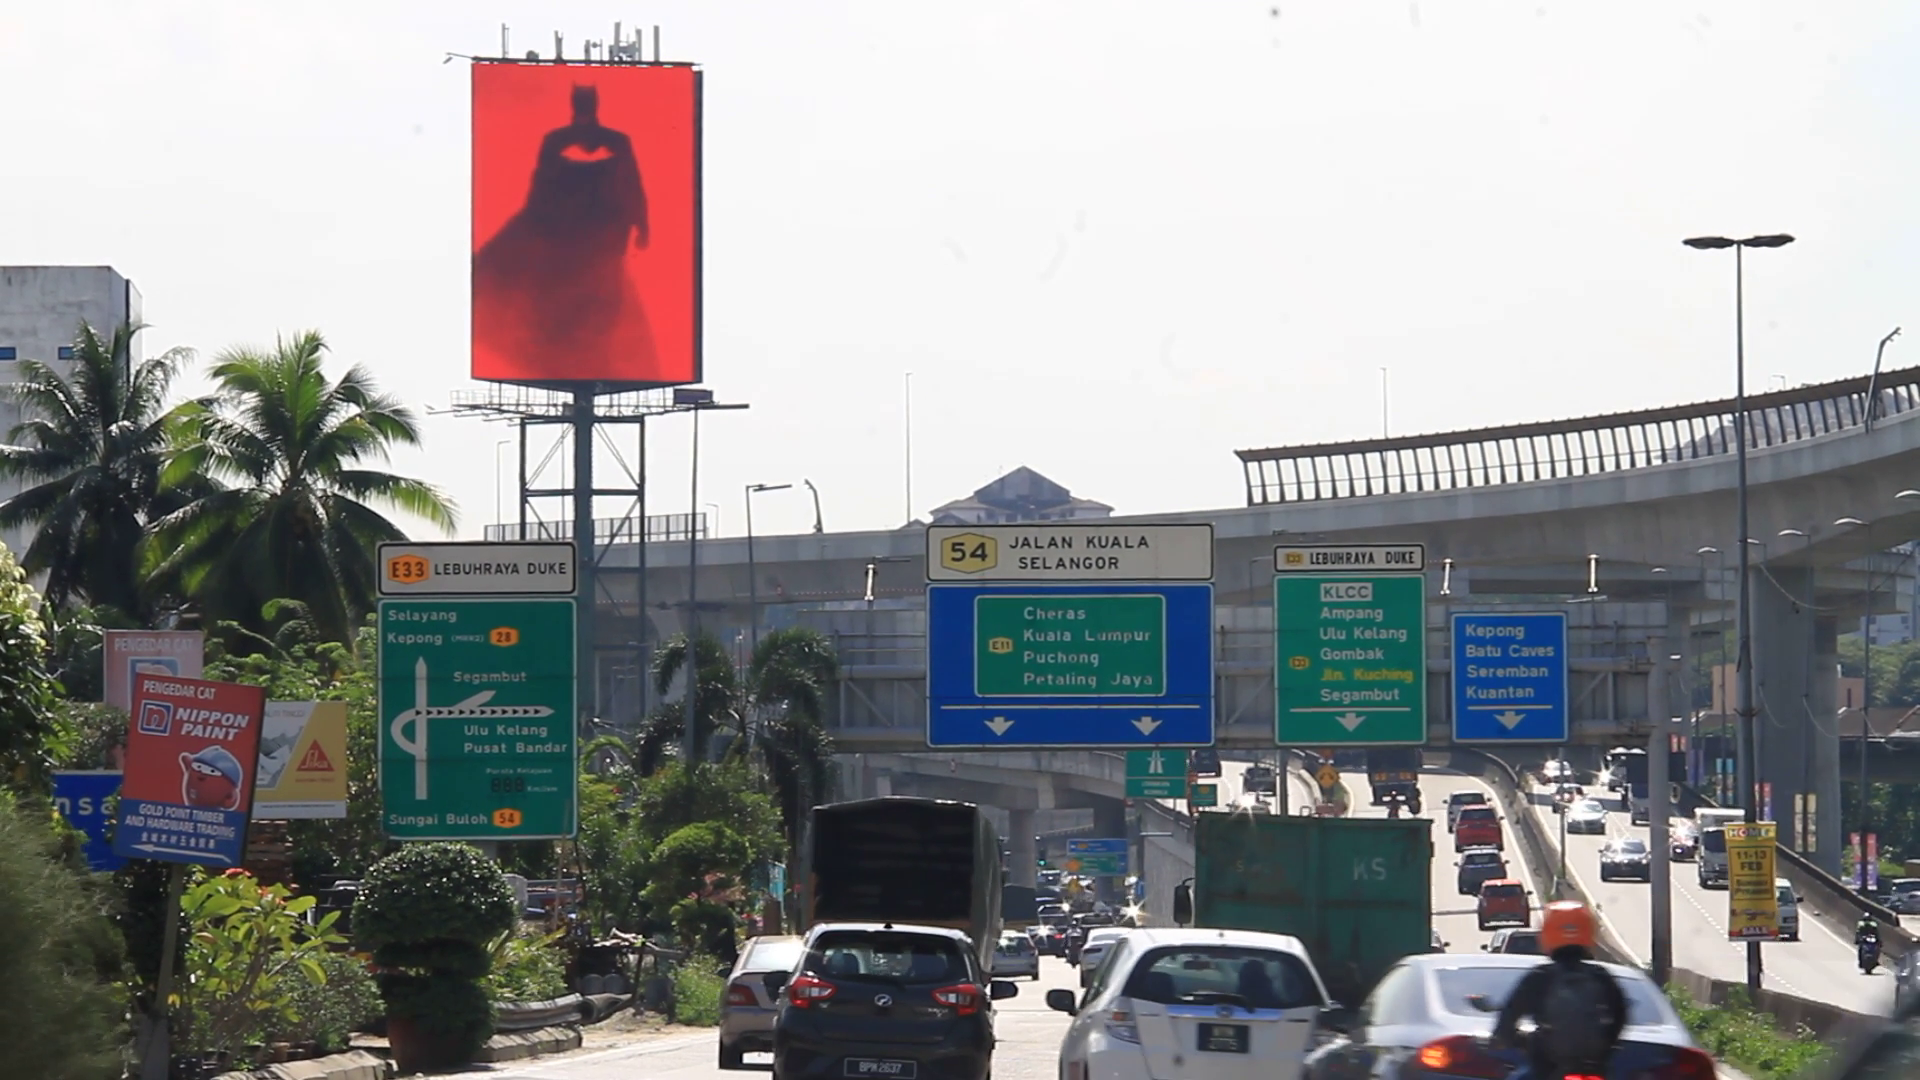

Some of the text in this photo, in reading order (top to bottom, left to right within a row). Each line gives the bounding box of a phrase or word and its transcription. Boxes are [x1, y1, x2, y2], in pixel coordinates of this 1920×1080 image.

[1009, 536, 1150, 549] JALAN KUALA
[950, 542, 988, 562] 54
[1310, 552, 1375, 565] LEBUHRAYA
[1386, 551, 1415, 564] DUKE
[391, 562, 567, 578] E33 LEBUHRAYA DUKE
[1018, 557, 1119, 570] SELANGOR
[1323, 586, 1369, 598] KLCC
[388, 609, 457, 623] Selayang
[1023, 607, 1086, 620] Cheras
[1320, 607, 1383, 622] Ampang
[387, 632, 443, 645] Kepong
[495, 632, 512, 642] 28
[1023, 629, 1151, 644] Kuala Lumpur
[1320, 628, 1407, 642] Ulu Kelang
[1466, 624, 1525, 639] Kepong
[114, 638, 193, 652] PENGEDAR CAT
[992, 640, 1010, 651] E11
[1466, 645, 1554, 657] Batu Caves
[1023, 652, 1099, 667] Puchong
[1320, 648, 1384, 660] Gombak
[453, 671, 527, 684] Segambut
[1353, 669, 1413, 683] Kuching
[1466, 665, 1550, 677] Seremban
[1023, 673, 1153, 689] Petaling Jaya
[143, 680, 216, 700] PENGEDAR CAT
[1320, 688, 1399, 703] Segambut
[1466, 686, 1534, 699] Kuantan
[175, 708, 249, 728] NIPPON
[181, 723, 239, 741] PAINT
[464, 725, 548, 738] Ulu Kelang
[464, 742, 568, 754] Pusat Bandar
[139, 804, 225, 823] GOLD POINT TIMBER
[389, 812, 515, 828] Sungai Buloh 54
[125, 815, 235, 837] AND HARDWARE TRADING
[1736, 850, 1767, 861] 11-13
[1353, 858, 1387, 881] KS
[1740, 862, 1763, 872] FEB
